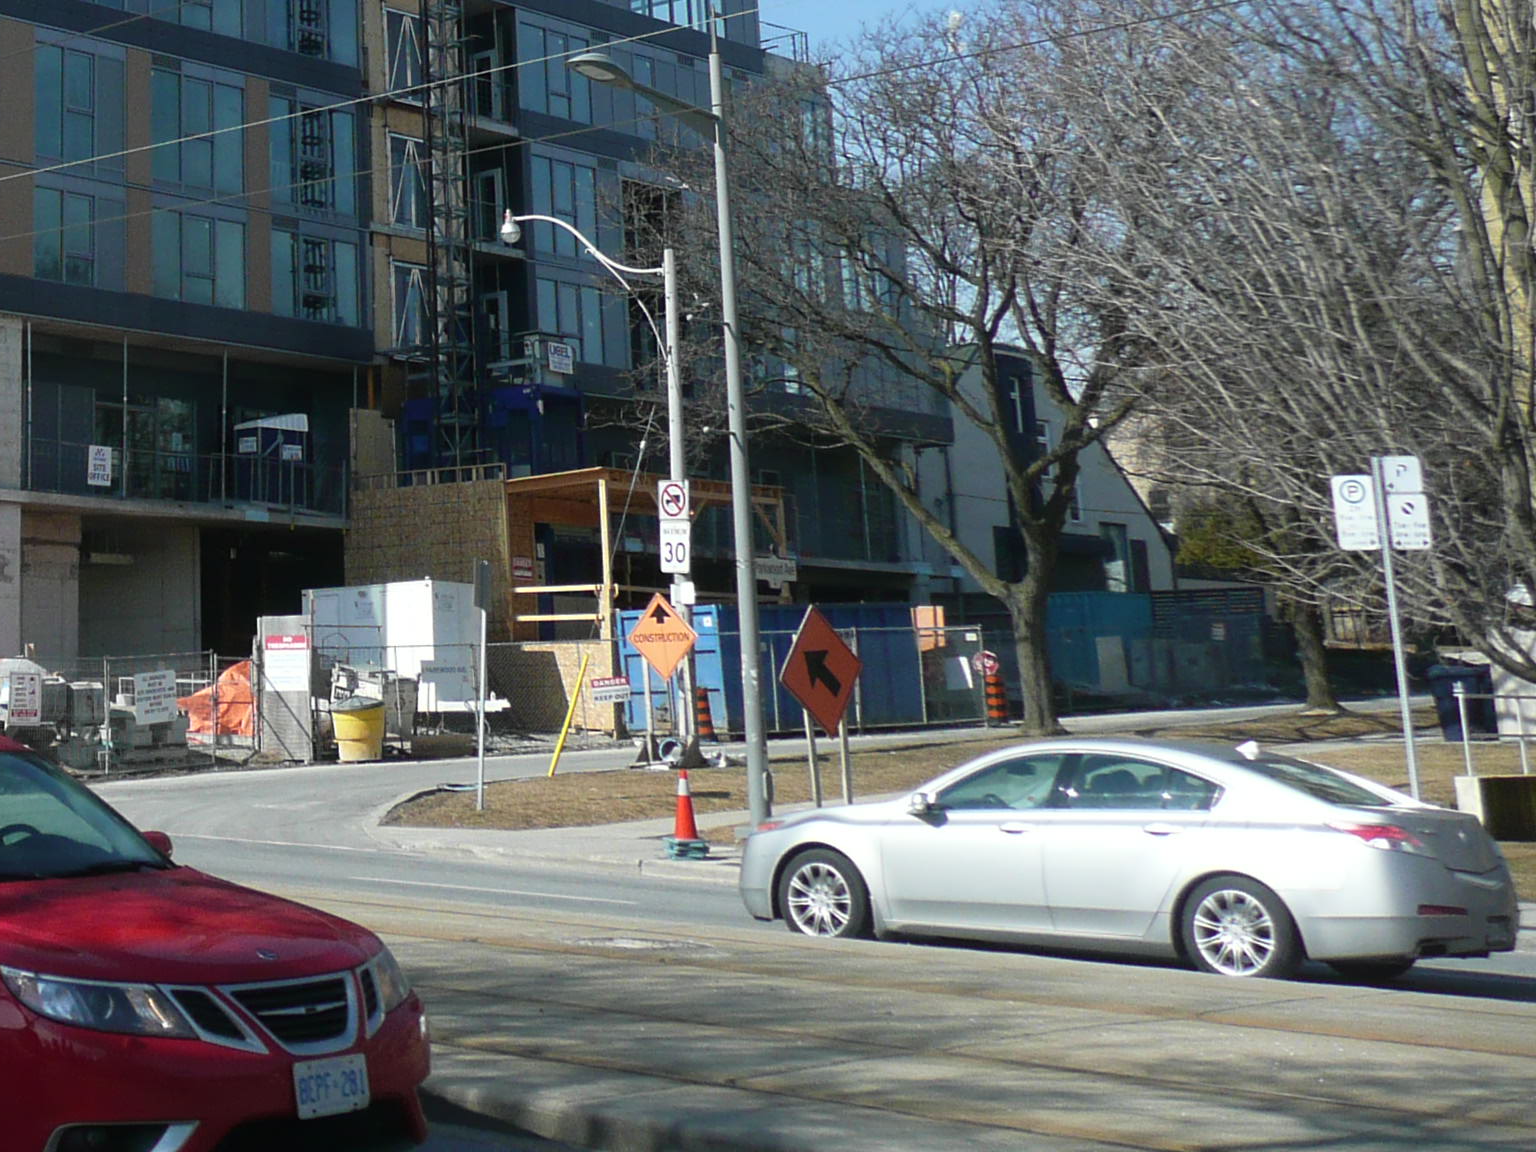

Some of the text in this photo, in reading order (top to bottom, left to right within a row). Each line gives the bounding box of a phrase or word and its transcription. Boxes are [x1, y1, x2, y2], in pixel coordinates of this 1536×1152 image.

[94, 463, 106, 472] SITE
[88, 472, 111, 482] OFFICE
[664, 542, 686, 563] 30
[633, 632, 690, 644] CONSTRUCTION
[592, 678, 627, 687] DANGER
